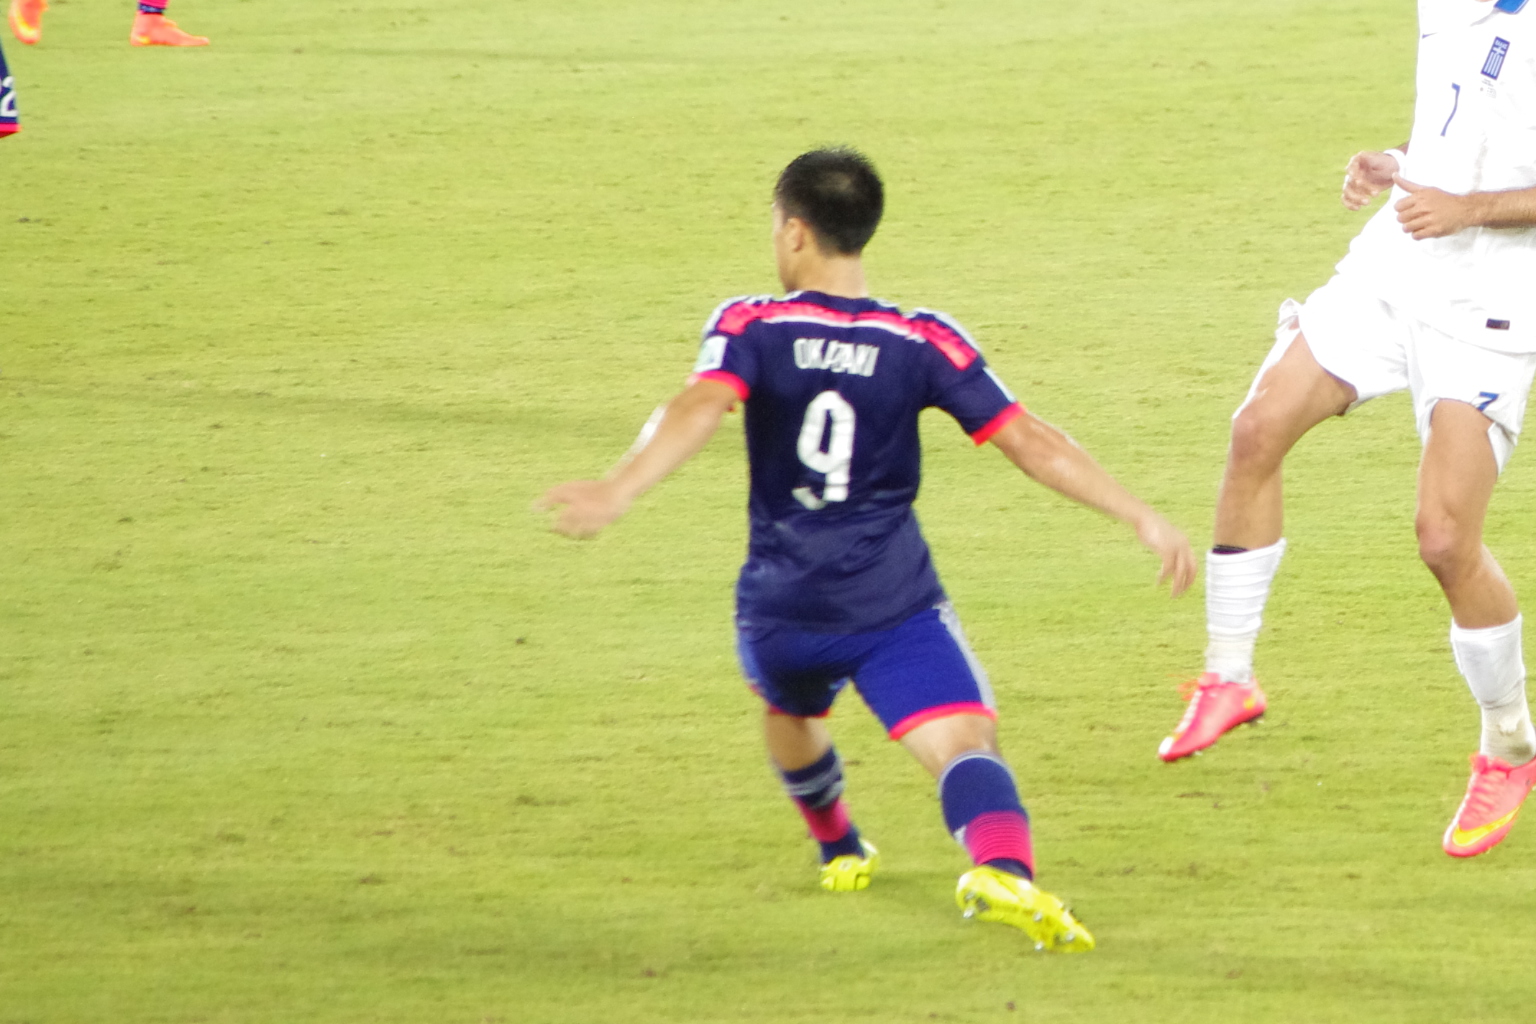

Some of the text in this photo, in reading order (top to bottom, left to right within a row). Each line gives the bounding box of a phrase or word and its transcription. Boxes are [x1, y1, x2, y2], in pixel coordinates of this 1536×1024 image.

[1440, 82, 1461, 137] 7
[1478, 391, 1499, 412] 7
[792, 390, 855, 510] 9
